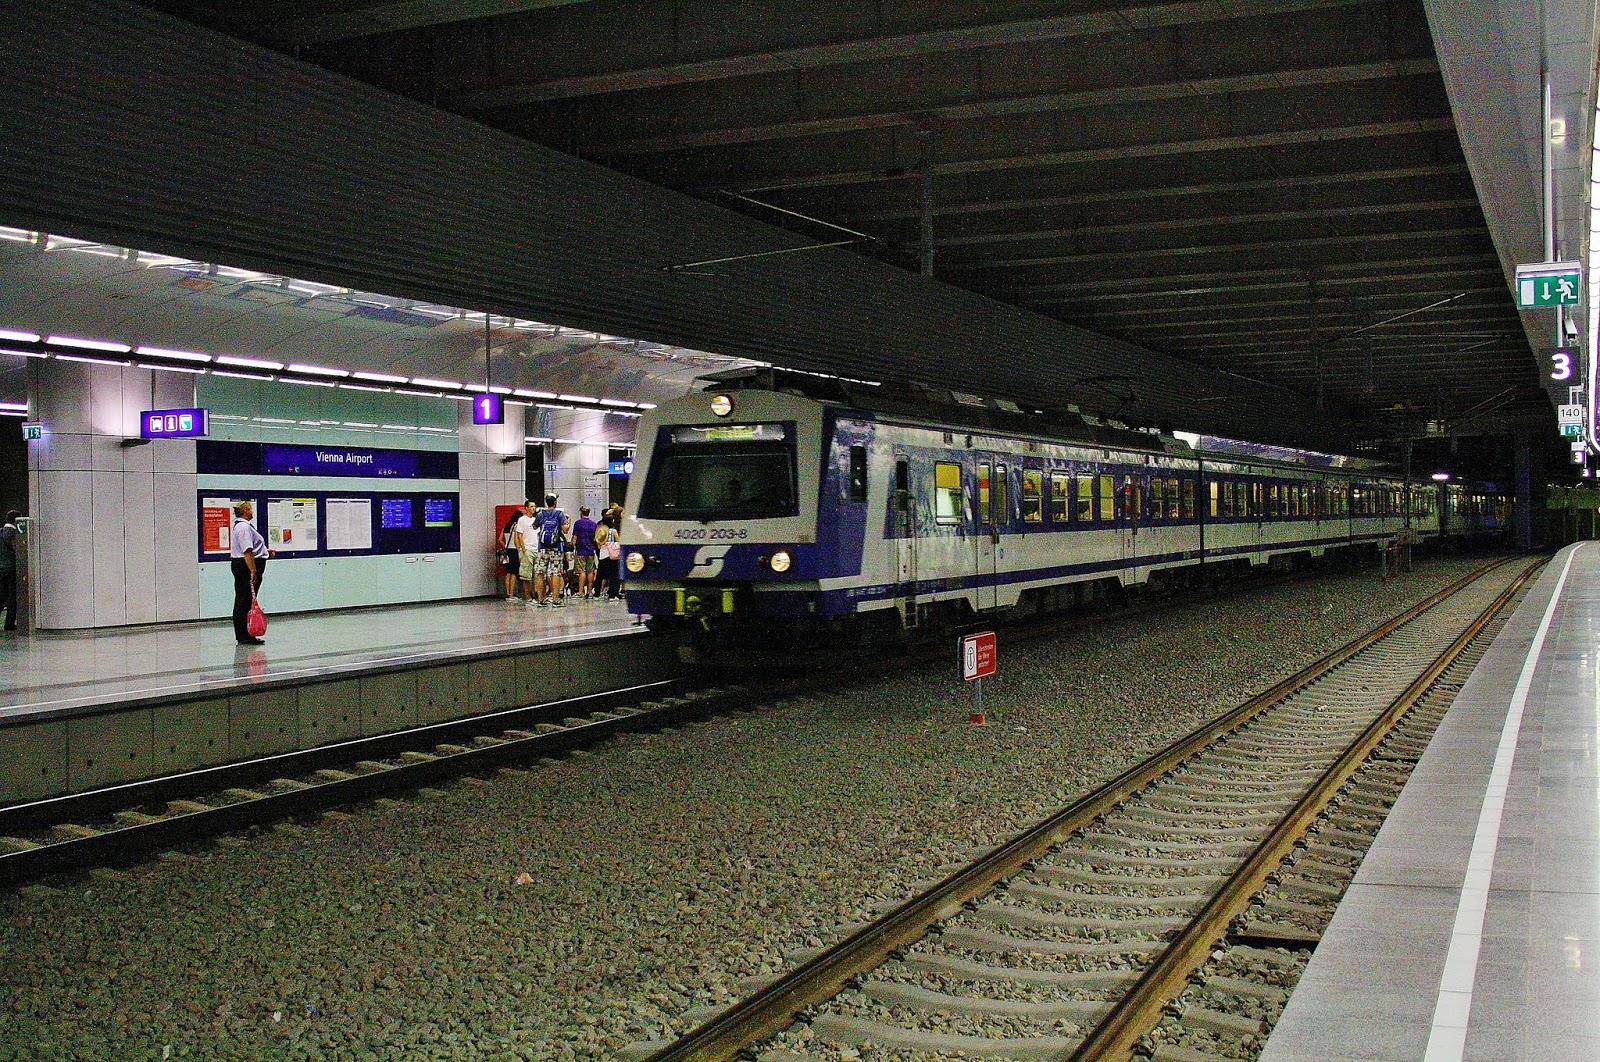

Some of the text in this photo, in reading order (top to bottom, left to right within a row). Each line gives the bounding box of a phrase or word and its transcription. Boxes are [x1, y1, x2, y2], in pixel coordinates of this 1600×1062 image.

[1551, 353, 1571, 380] 3
[480, 398, 490, 420] 1
[1560, 408, 1580, 418] 140
[315, 451, 374, 467] Vienna Airport
[1573, 451, 1583, 463] 3
[674, 527, 748, 540] 4020 203-8
